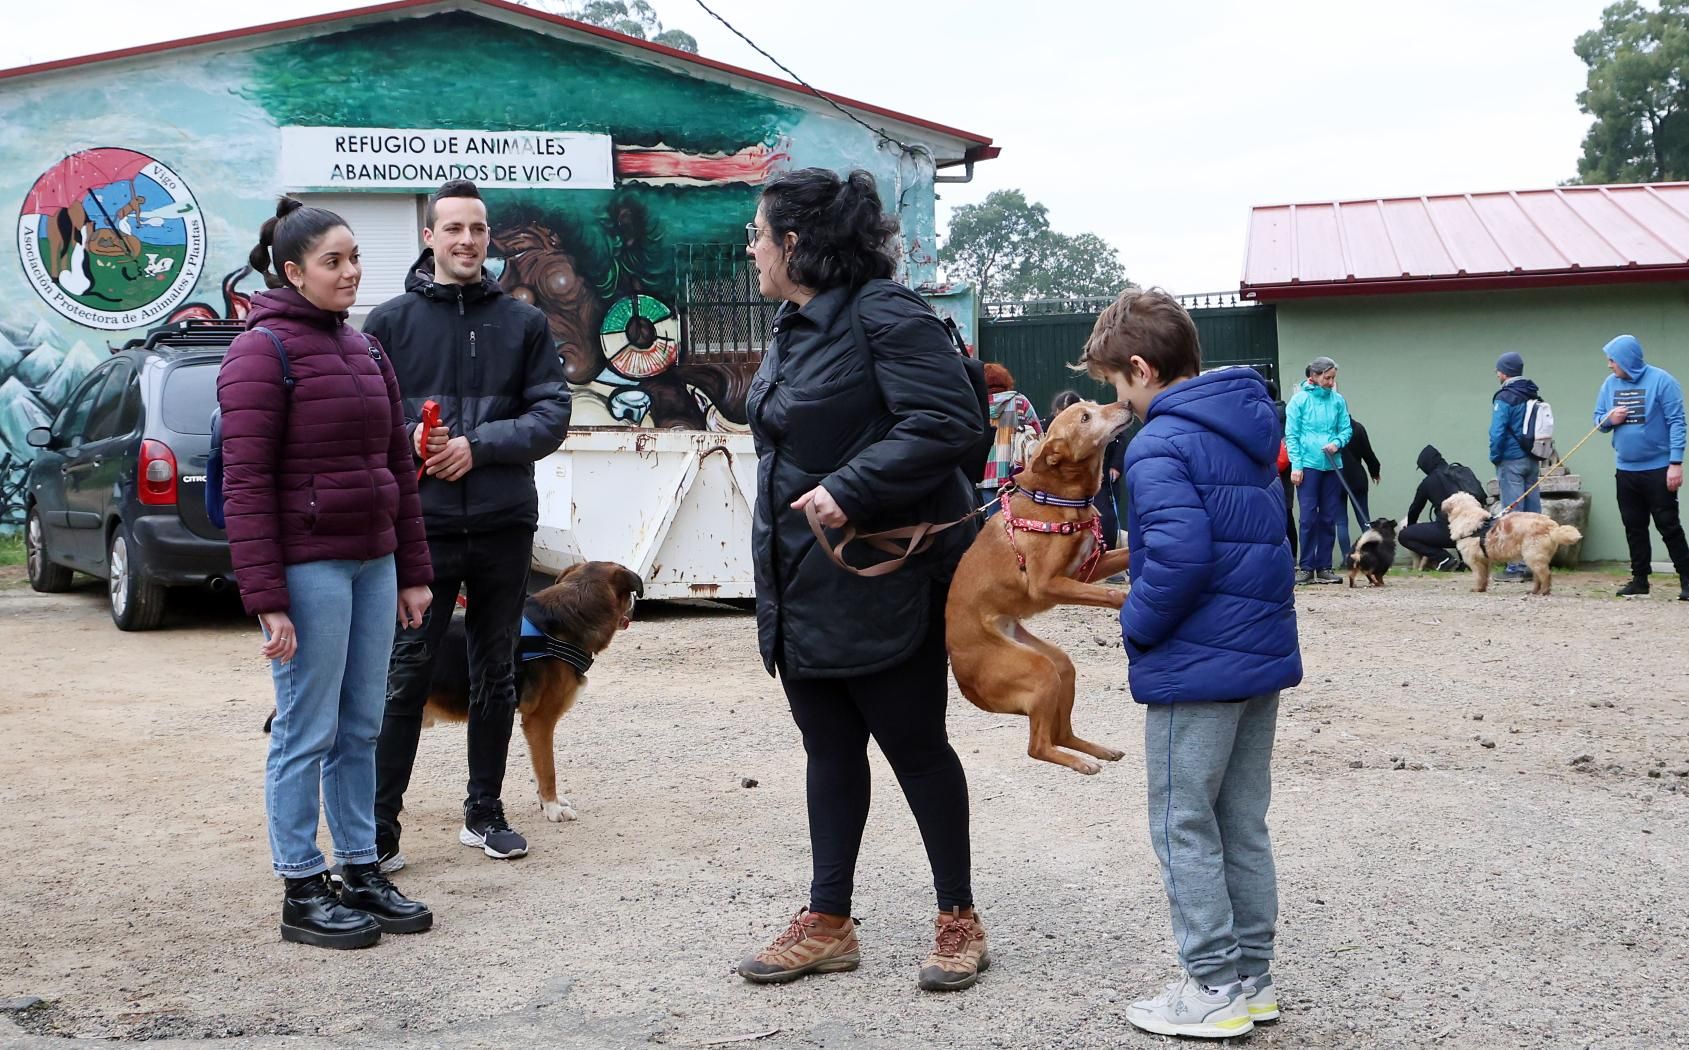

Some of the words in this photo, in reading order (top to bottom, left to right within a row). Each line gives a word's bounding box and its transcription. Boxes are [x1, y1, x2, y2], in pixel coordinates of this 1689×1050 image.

[336, 136, 426, 154] REFUGIO
[434, 137, 458, 154] DE
[466, 137, 566, 155] ANIMALES
[153, 166, 176, 190] Vigo
[331, 164, 488, 180] ABANDONADOS
[495, 166, 517, 181] DE
[522, 166, 572, 182] VIGO
[188, 220, 202, 266] Plantas
[24, 226, 52, 295] Asociación
[186, 270, 196, 280] y
[54, 294, 118, 324] Protectora
[142, 280, 189, 320] Animales
[122, 313, 137, 324] de
